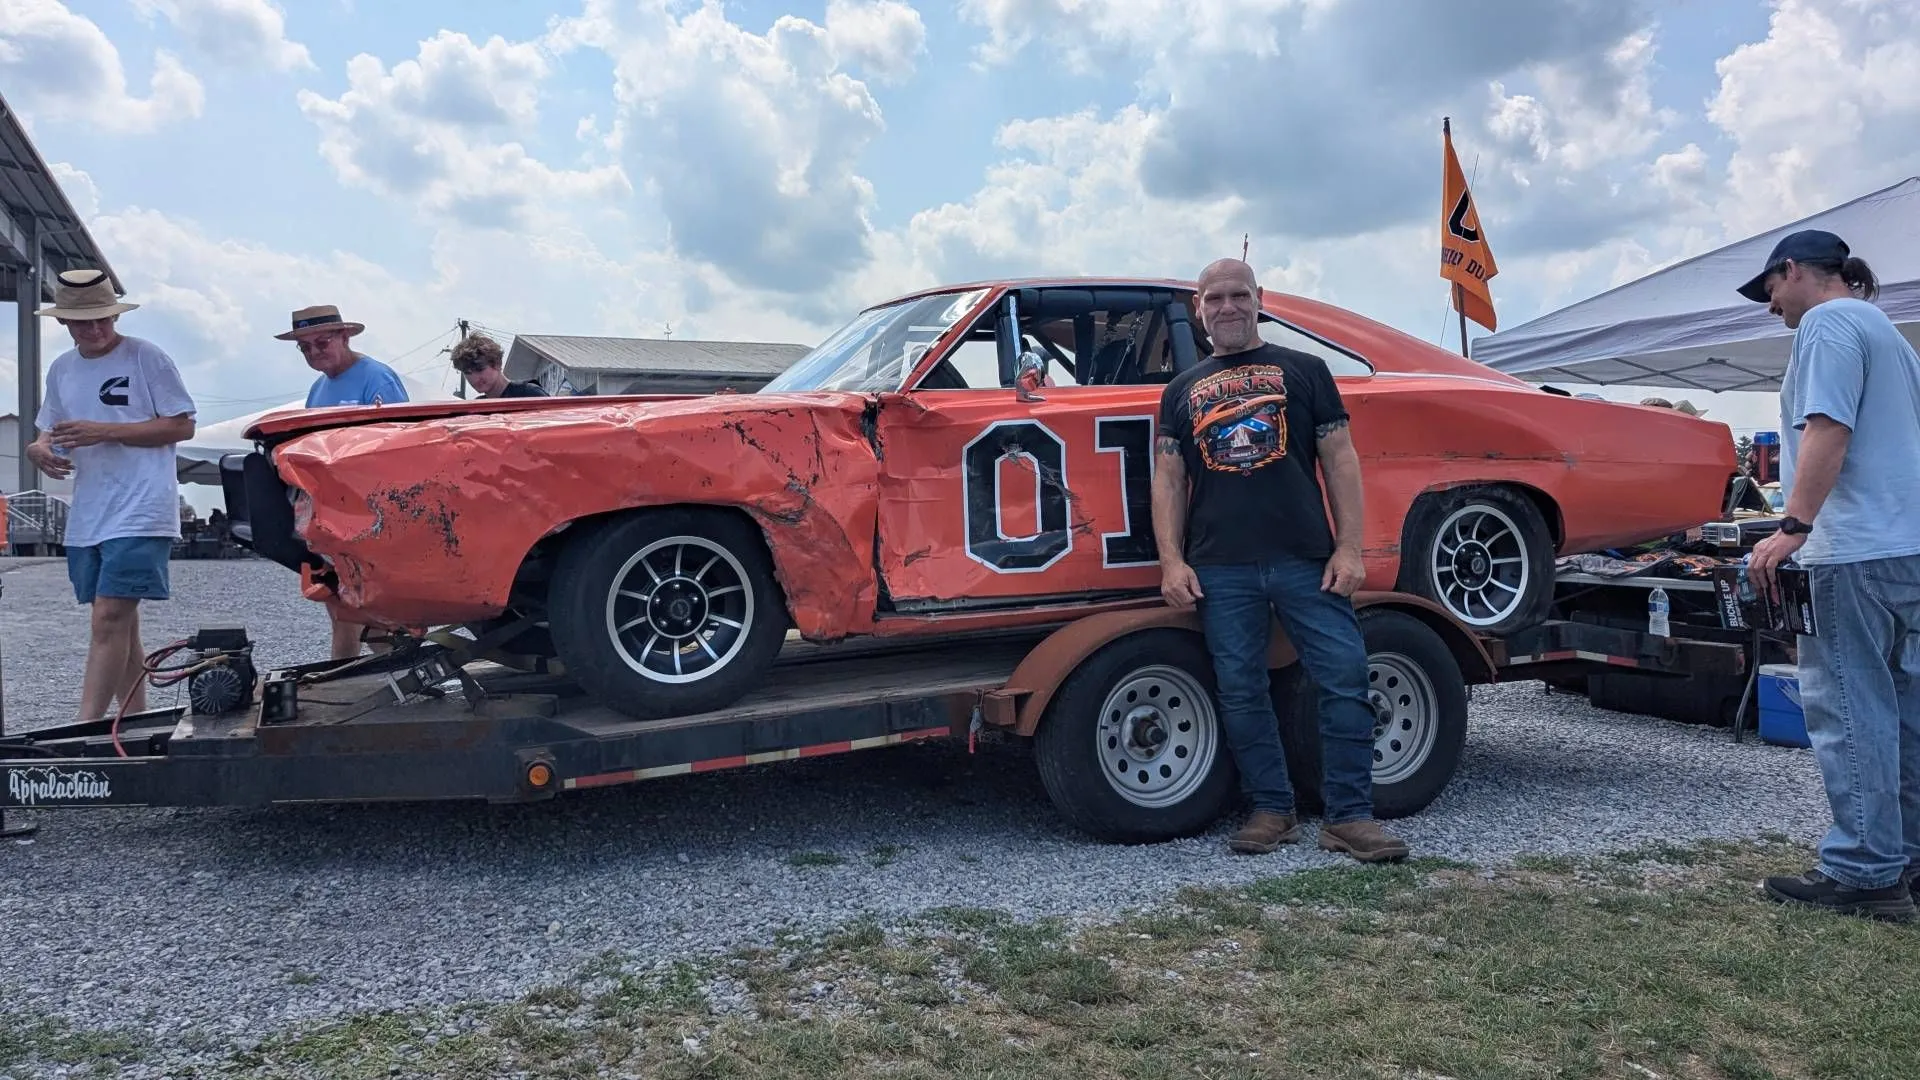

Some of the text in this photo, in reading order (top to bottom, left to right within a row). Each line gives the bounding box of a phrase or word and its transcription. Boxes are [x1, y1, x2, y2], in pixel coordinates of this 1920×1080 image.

[1465, 258, 1487, 282] DU
[1188, 375, 1288, 420] DUKES
[962, 414, 1162, 574] 01
[1720, 579, 1731, 592] UP
[1723, 593, 1739, 627] BUCKLE
[9, 772, 112, 805] Appalachian
